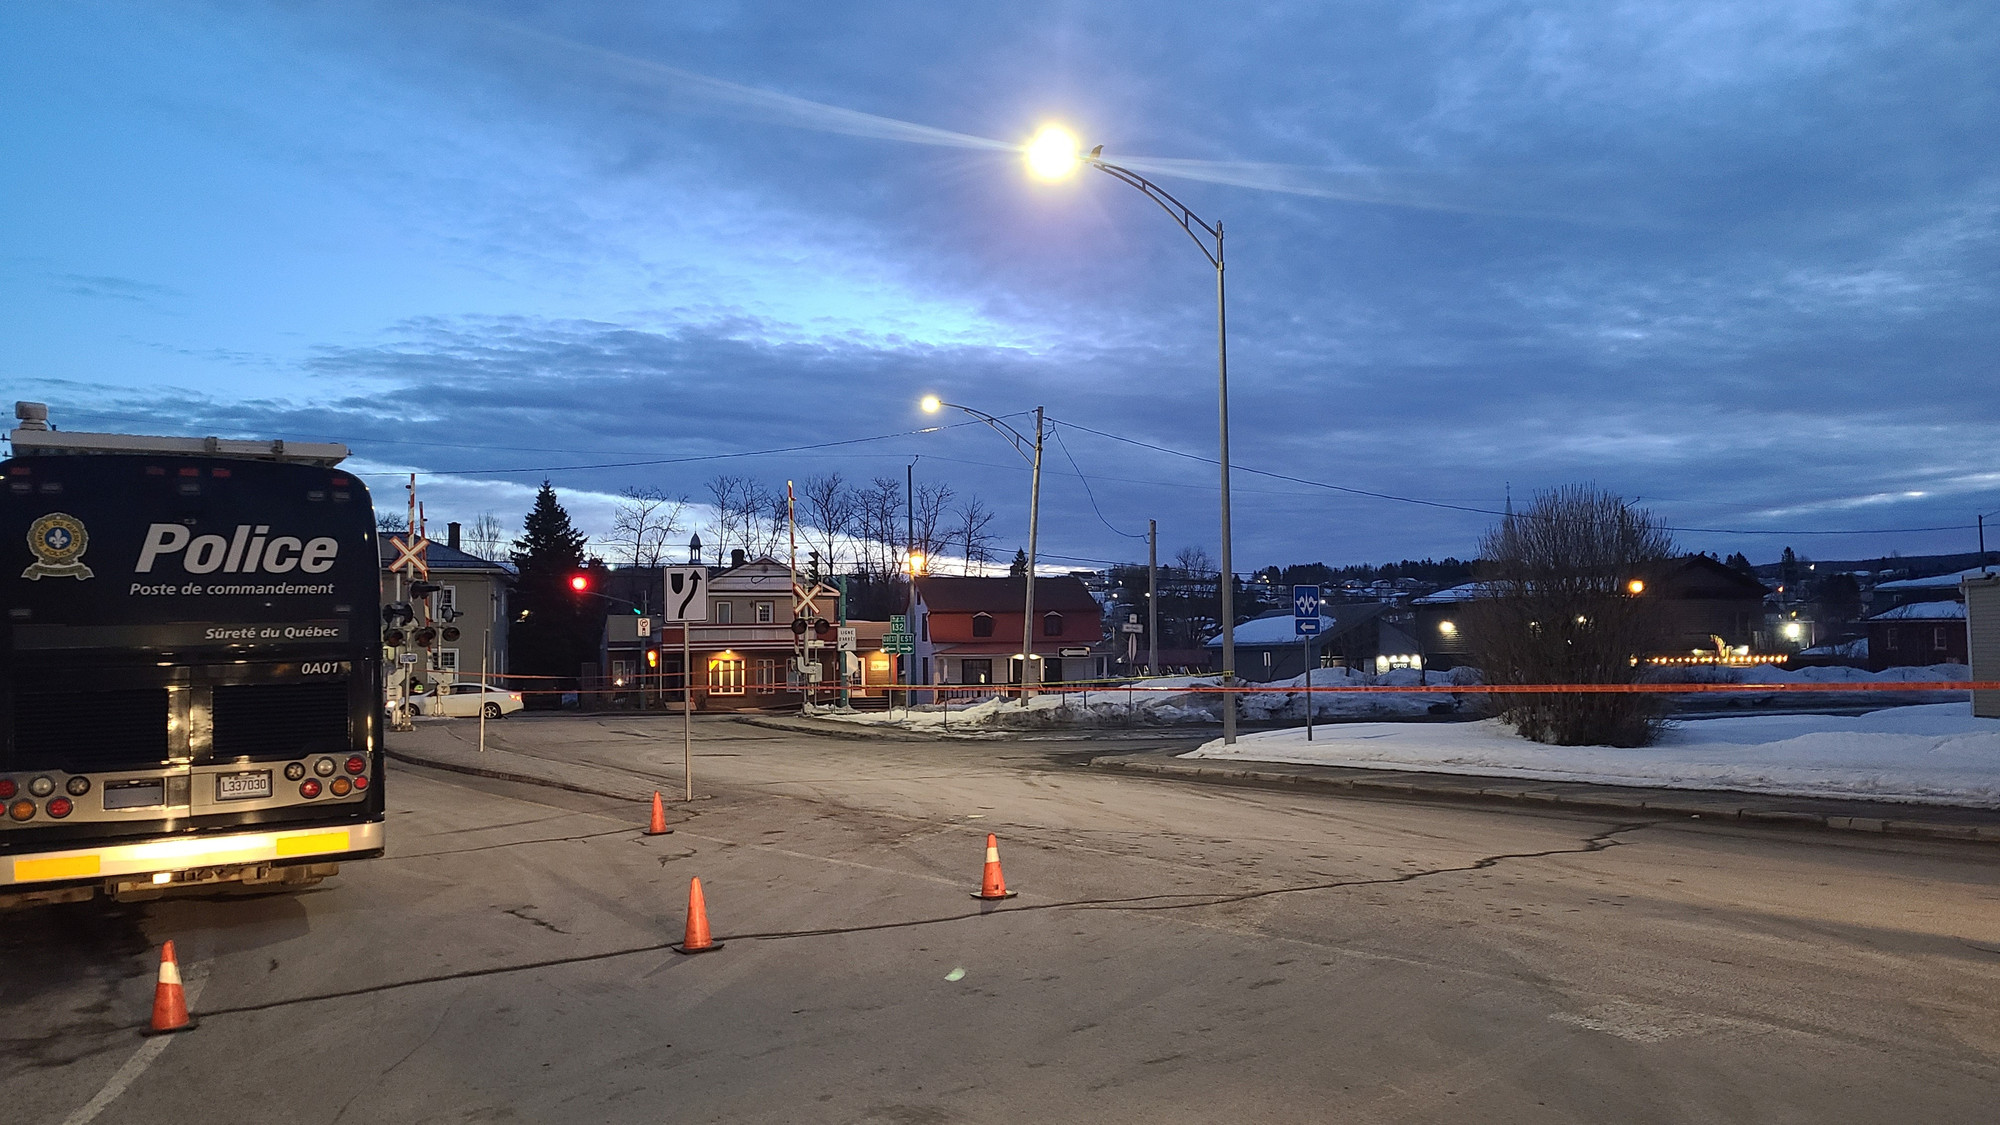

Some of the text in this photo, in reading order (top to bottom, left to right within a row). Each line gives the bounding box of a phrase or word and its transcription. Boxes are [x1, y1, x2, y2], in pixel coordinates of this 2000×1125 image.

[134, 523, 339, 574] Police
[129, 582, 335, 596] Poste de commandement
[205, 626, 339, 640] Sûreté du Québec
[892, 623, 904, 632] 132
[301, 662, 339, 675] 0A01
[222, 779, 266, 791] L337030
